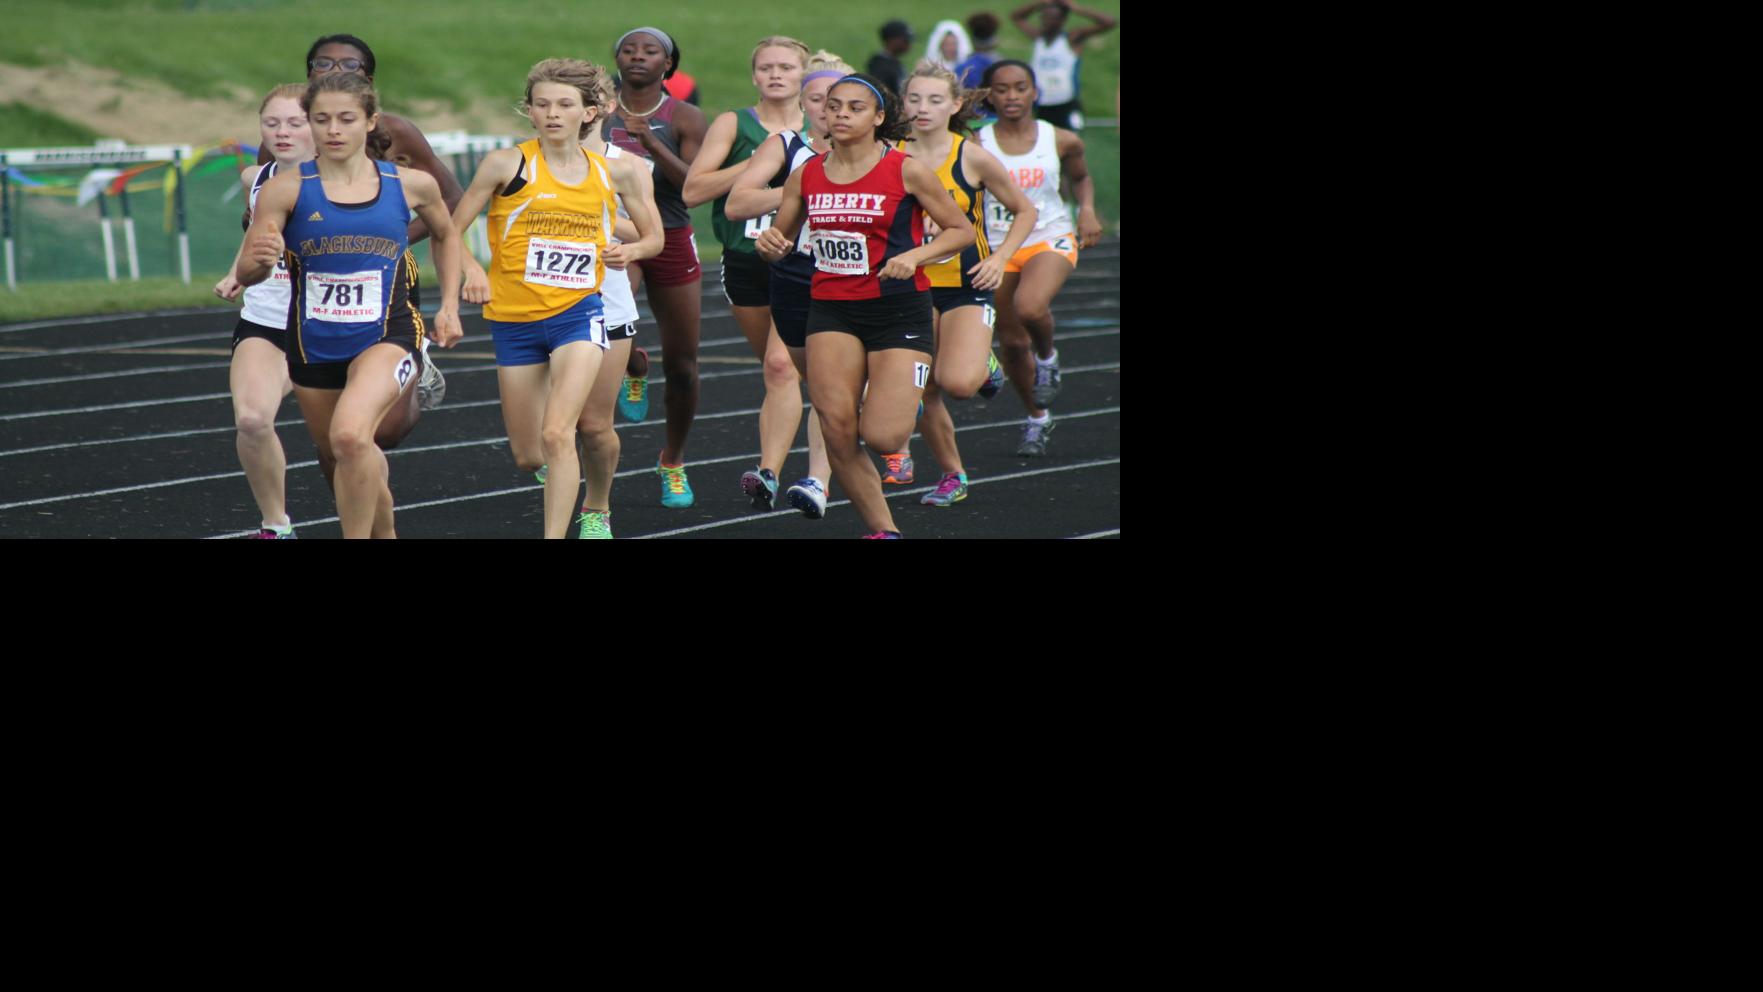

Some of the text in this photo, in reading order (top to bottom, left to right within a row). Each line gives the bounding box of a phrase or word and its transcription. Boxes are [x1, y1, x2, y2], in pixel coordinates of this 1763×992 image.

[808, 193, 886, 210] LIBERTY
[816, 239, 863, 261] 1083
[534, 250, 592, 275] 1272
[550, 274, 589, 283] ATHLETIC
[319, 283, 364, 306] 781
[398, 359, 411, 387] 8
